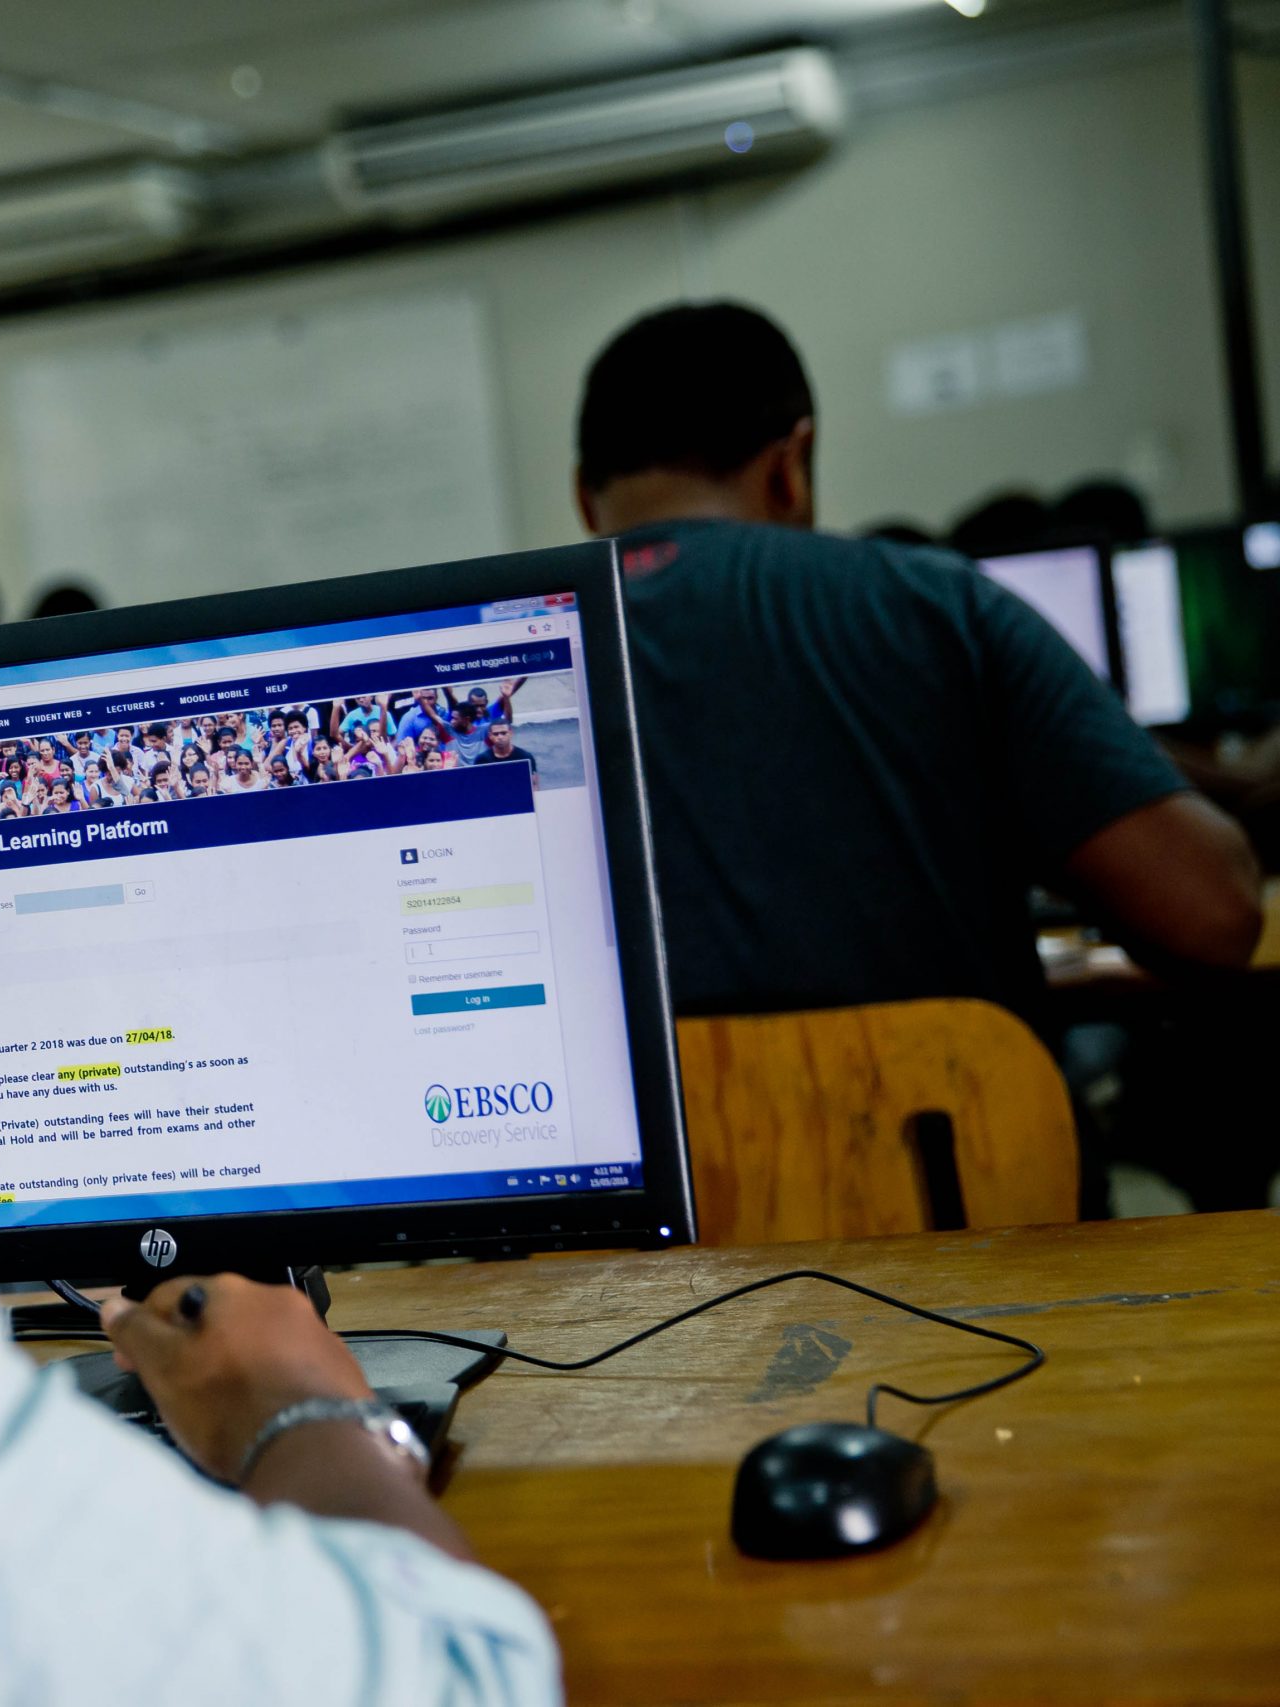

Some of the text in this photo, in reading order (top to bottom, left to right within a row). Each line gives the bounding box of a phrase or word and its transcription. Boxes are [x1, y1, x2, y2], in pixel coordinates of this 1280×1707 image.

[434, 664, 451, 673] You
[452, 663, 465, 671] are
[467, 660, 481, 669] not
[481, 656, 509, 668] logged
[179, 688, 250, 705] MOODLE MOBILE
[265, 684, 288, 694] HELP
[106, 700, 155, 714] LECTURERS
[25, 710, 82, 724] STUDENT WEB
[86, 819, 169, 842] Platform
[421, 848, 453, 859] LOGIN
[397, 877, 437, 887] Username
[134, 888, 146, 896] Go
[402, 925, 441, 935] Password
[419, 969, 503, 984] Remember username
[465, 996, 481, 1006] Log
[414, 1023, 475, 1035] Lost password?
[31, 1041, 37, 1051] 2
[39, 1039, 64, 1050] 2018
[66, 1038, 86, 1047] was
[88, 1036, 108, 1047] due
[110, 1035, 123, 1044] on
[125, 1030, 176, 1044] 27/04/18.
[31, 1070, 56, 1082] clear
[57, 1070, 76, 1081] any
[78, 1065, 121, 1080] (private)
[196, 1059, 207, 1068] as
[210, 1056, 235, 1067] soon
[237, 1056, 249, 1065] as
[6, 1087, 30, 1100] have
[32, 1087, 50, 1099] any
[52, 1084, 76, 1096] dues
[78, 1082, 101, 1093] with
[103, 1082, 118, 1092] us.
[454, 1081, 553, 1118] EBSCO
[44, 1113, 104, 1127] outstanding
[109, 1112, 129, 1122] fees
[134, 1110, 152, 1120] will
[156, 1108, 181, 1119] have
[185, 1105, 210, 1116] their
[214, 1102, 254, 1114] student
[10, 1134, 34, 1145] Hold
[38, 1132, 57, 1143] and
[61, 1130, 79, 1141] will
[83, 1130, 96, 1140] be
[100, 1127, 133, 1138] barred
[138, 1125, 163, 1135] from
[167, 1123, 200, 1133] exams
[204, 1120, 223, 1131] and
[227, 1118, 256, 1129] other
[431, 1122, 557, 1148] Discovery Service
[19, 1177, 79, 1190] outstanding
[83, 1175, 108, 1187] (only
[112, 1172, 148, 1185] private
[152, 1170, 176, 1181] fees)
[180, 1168, 198, 1179] will
[202, 1167, 215, 1177] be
[219, 1164, 261, 1177] charged
[609, 1166, 623, 1174] PM
[145, 1229, 172, 1267] hp
